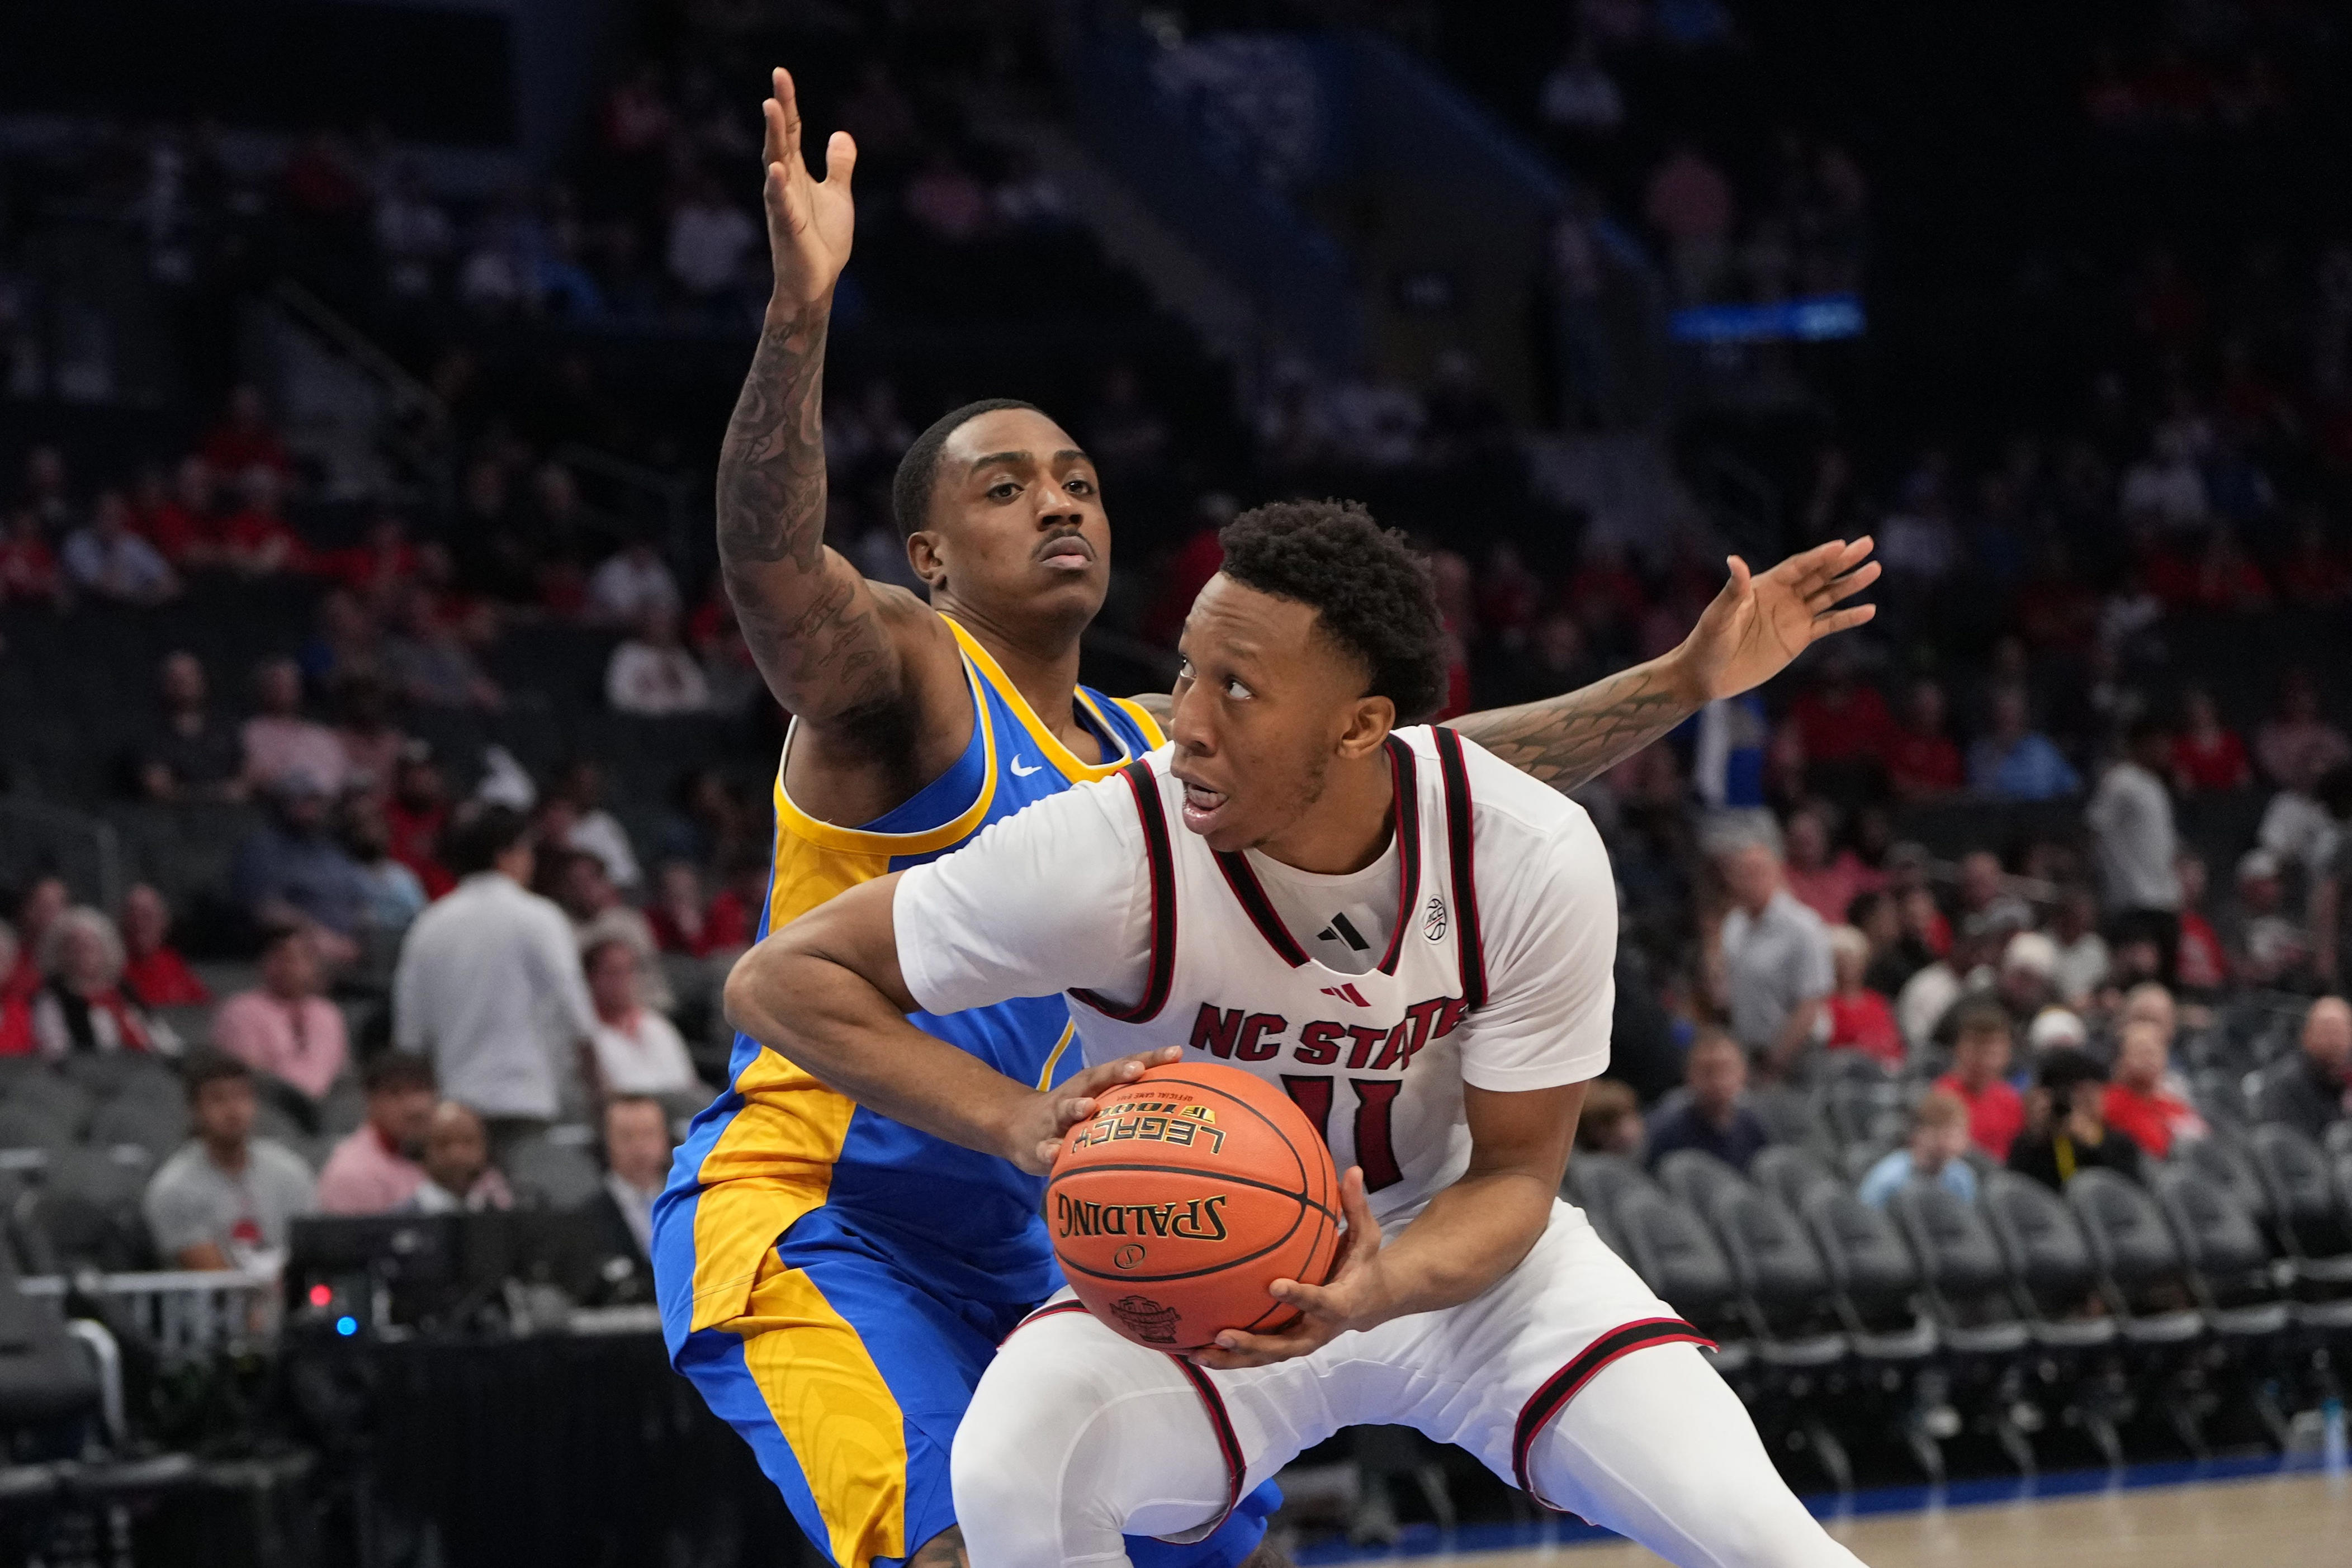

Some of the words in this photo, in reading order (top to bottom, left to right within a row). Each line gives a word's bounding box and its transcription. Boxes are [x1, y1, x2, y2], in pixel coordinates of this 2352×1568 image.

[1189, 1002, 1288, 1062] NC
[1294, 996, 1469, 1072] STATE
[1091, 1101, 1179, 1120] 1000
[1158, 1092, 1192, 1101] OFFICIAL
[1180, 1106, 1215, 1124] TF
[1071, 1117, 1226, 1155] LEGACY
[1058, 1193, 1228, 1242] SPALDING
